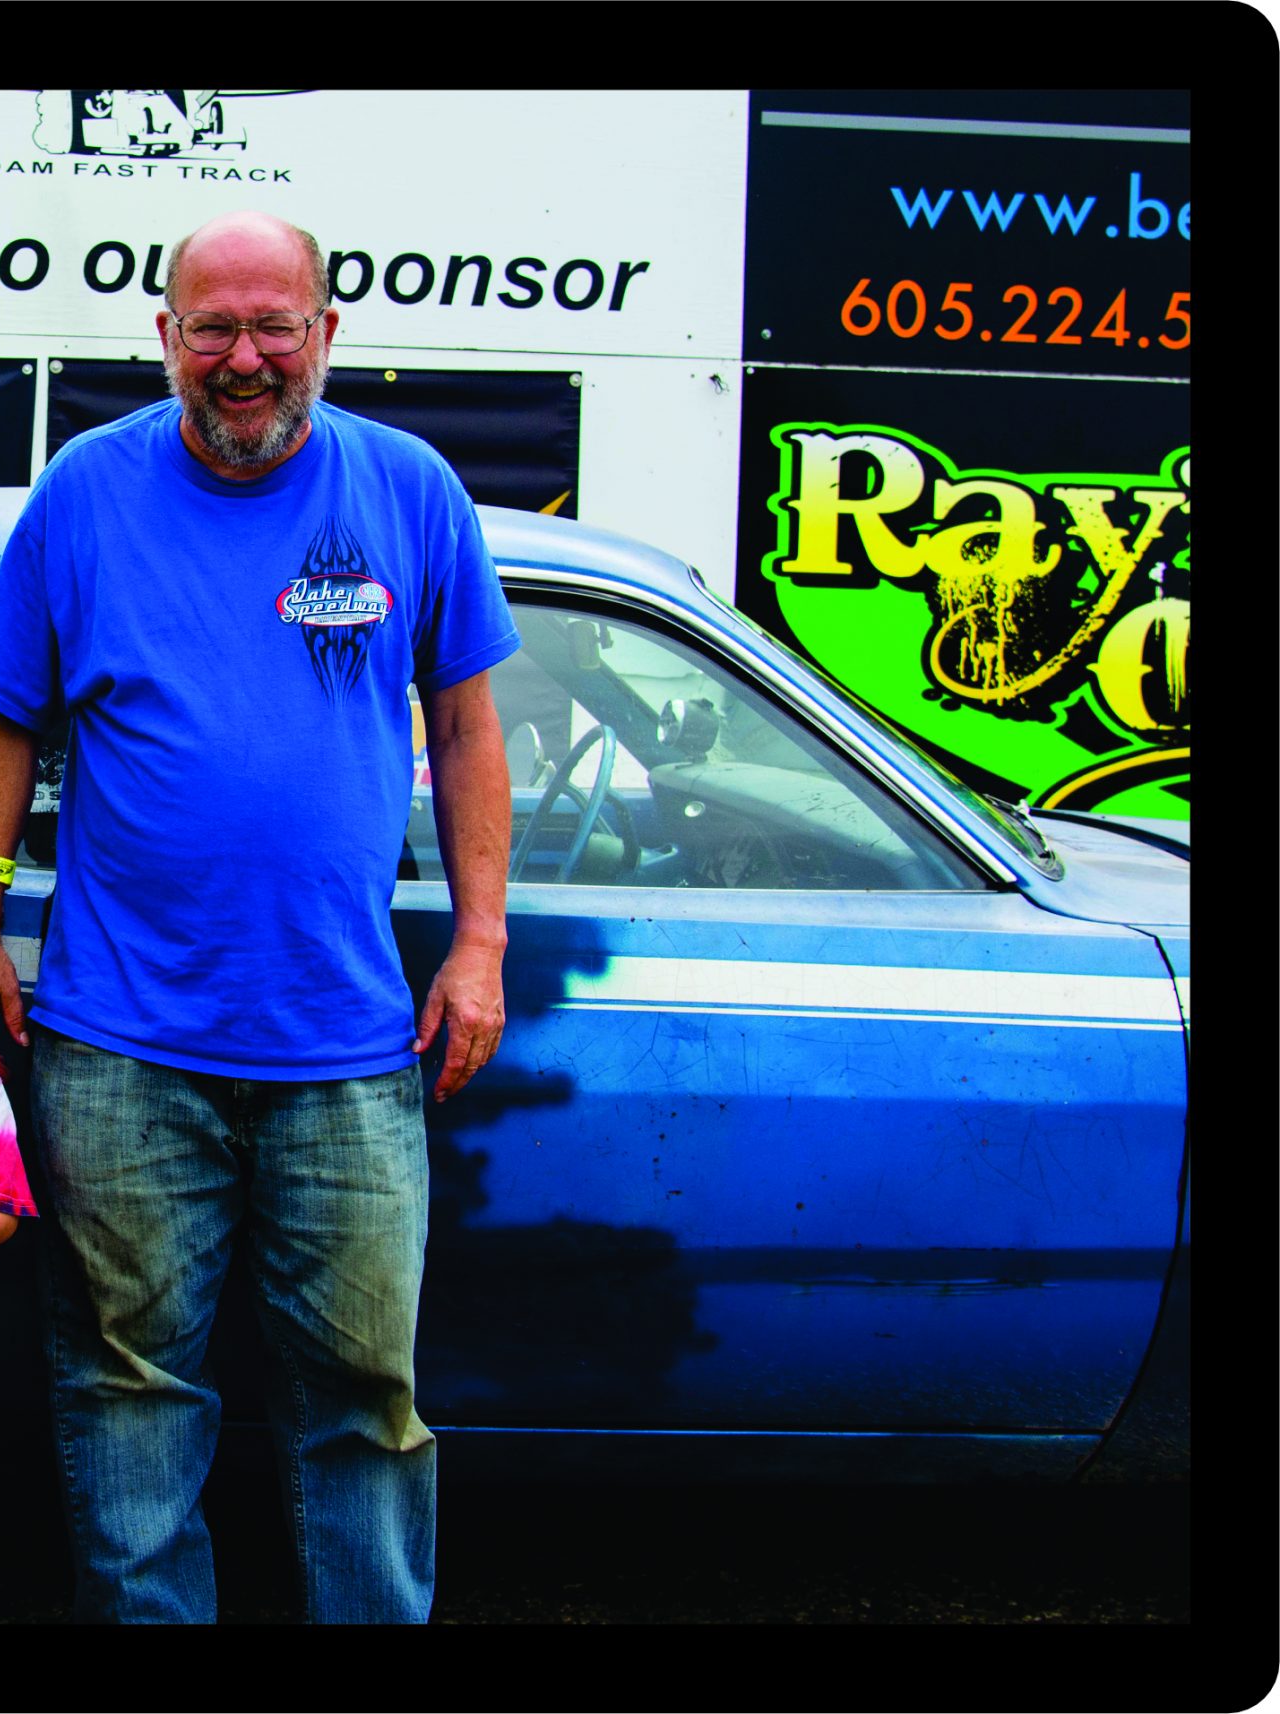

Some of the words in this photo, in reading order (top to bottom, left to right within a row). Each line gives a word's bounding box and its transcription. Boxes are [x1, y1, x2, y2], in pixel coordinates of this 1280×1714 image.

[73, 162, 159, 178] FAST
[177, 165, 293, 183] TRACK
[326, 249, 651, 312] ponsor
[280, 590, 390, 625] Speedway
